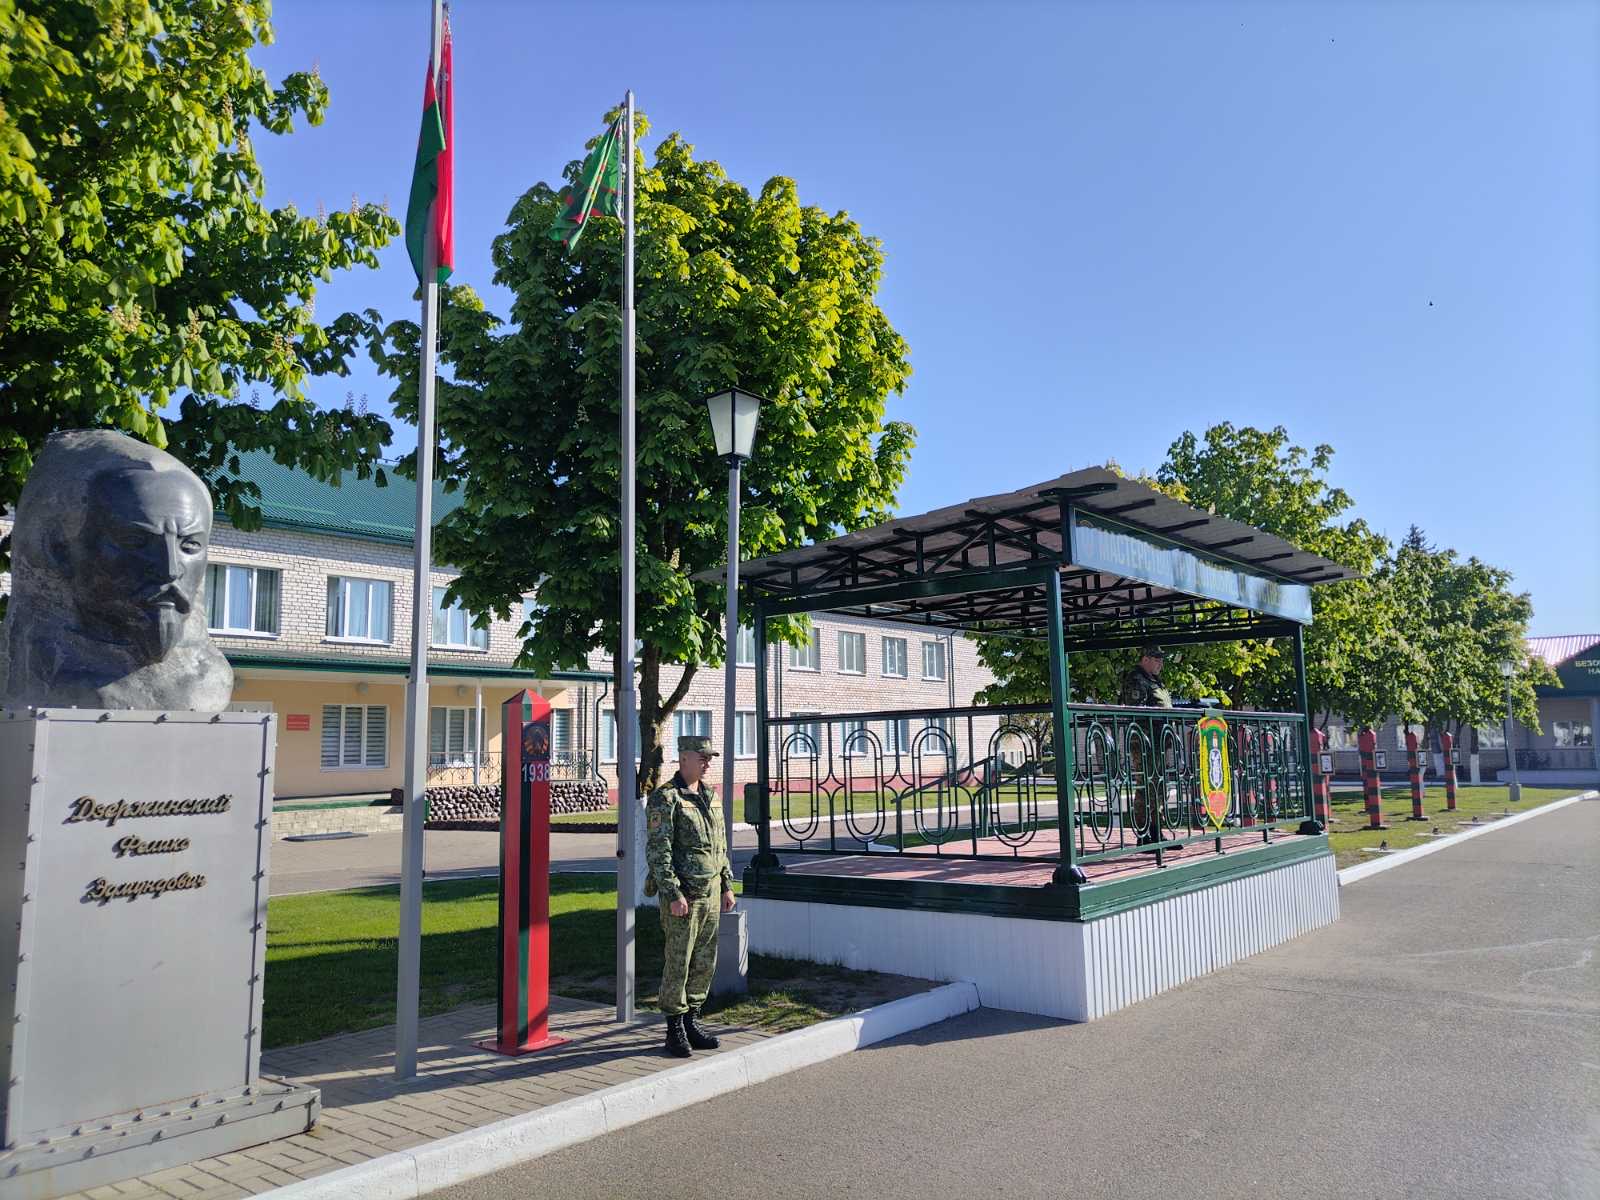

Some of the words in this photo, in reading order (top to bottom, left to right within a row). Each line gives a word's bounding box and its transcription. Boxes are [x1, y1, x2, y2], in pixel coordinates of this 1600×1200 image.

[521, 763, 550, 782] 1938
[66, 794, 231, 826] Дзержинский
[115, 835, 190, 857] Феликс
[82, 872, 206, 905] Эдмундович
